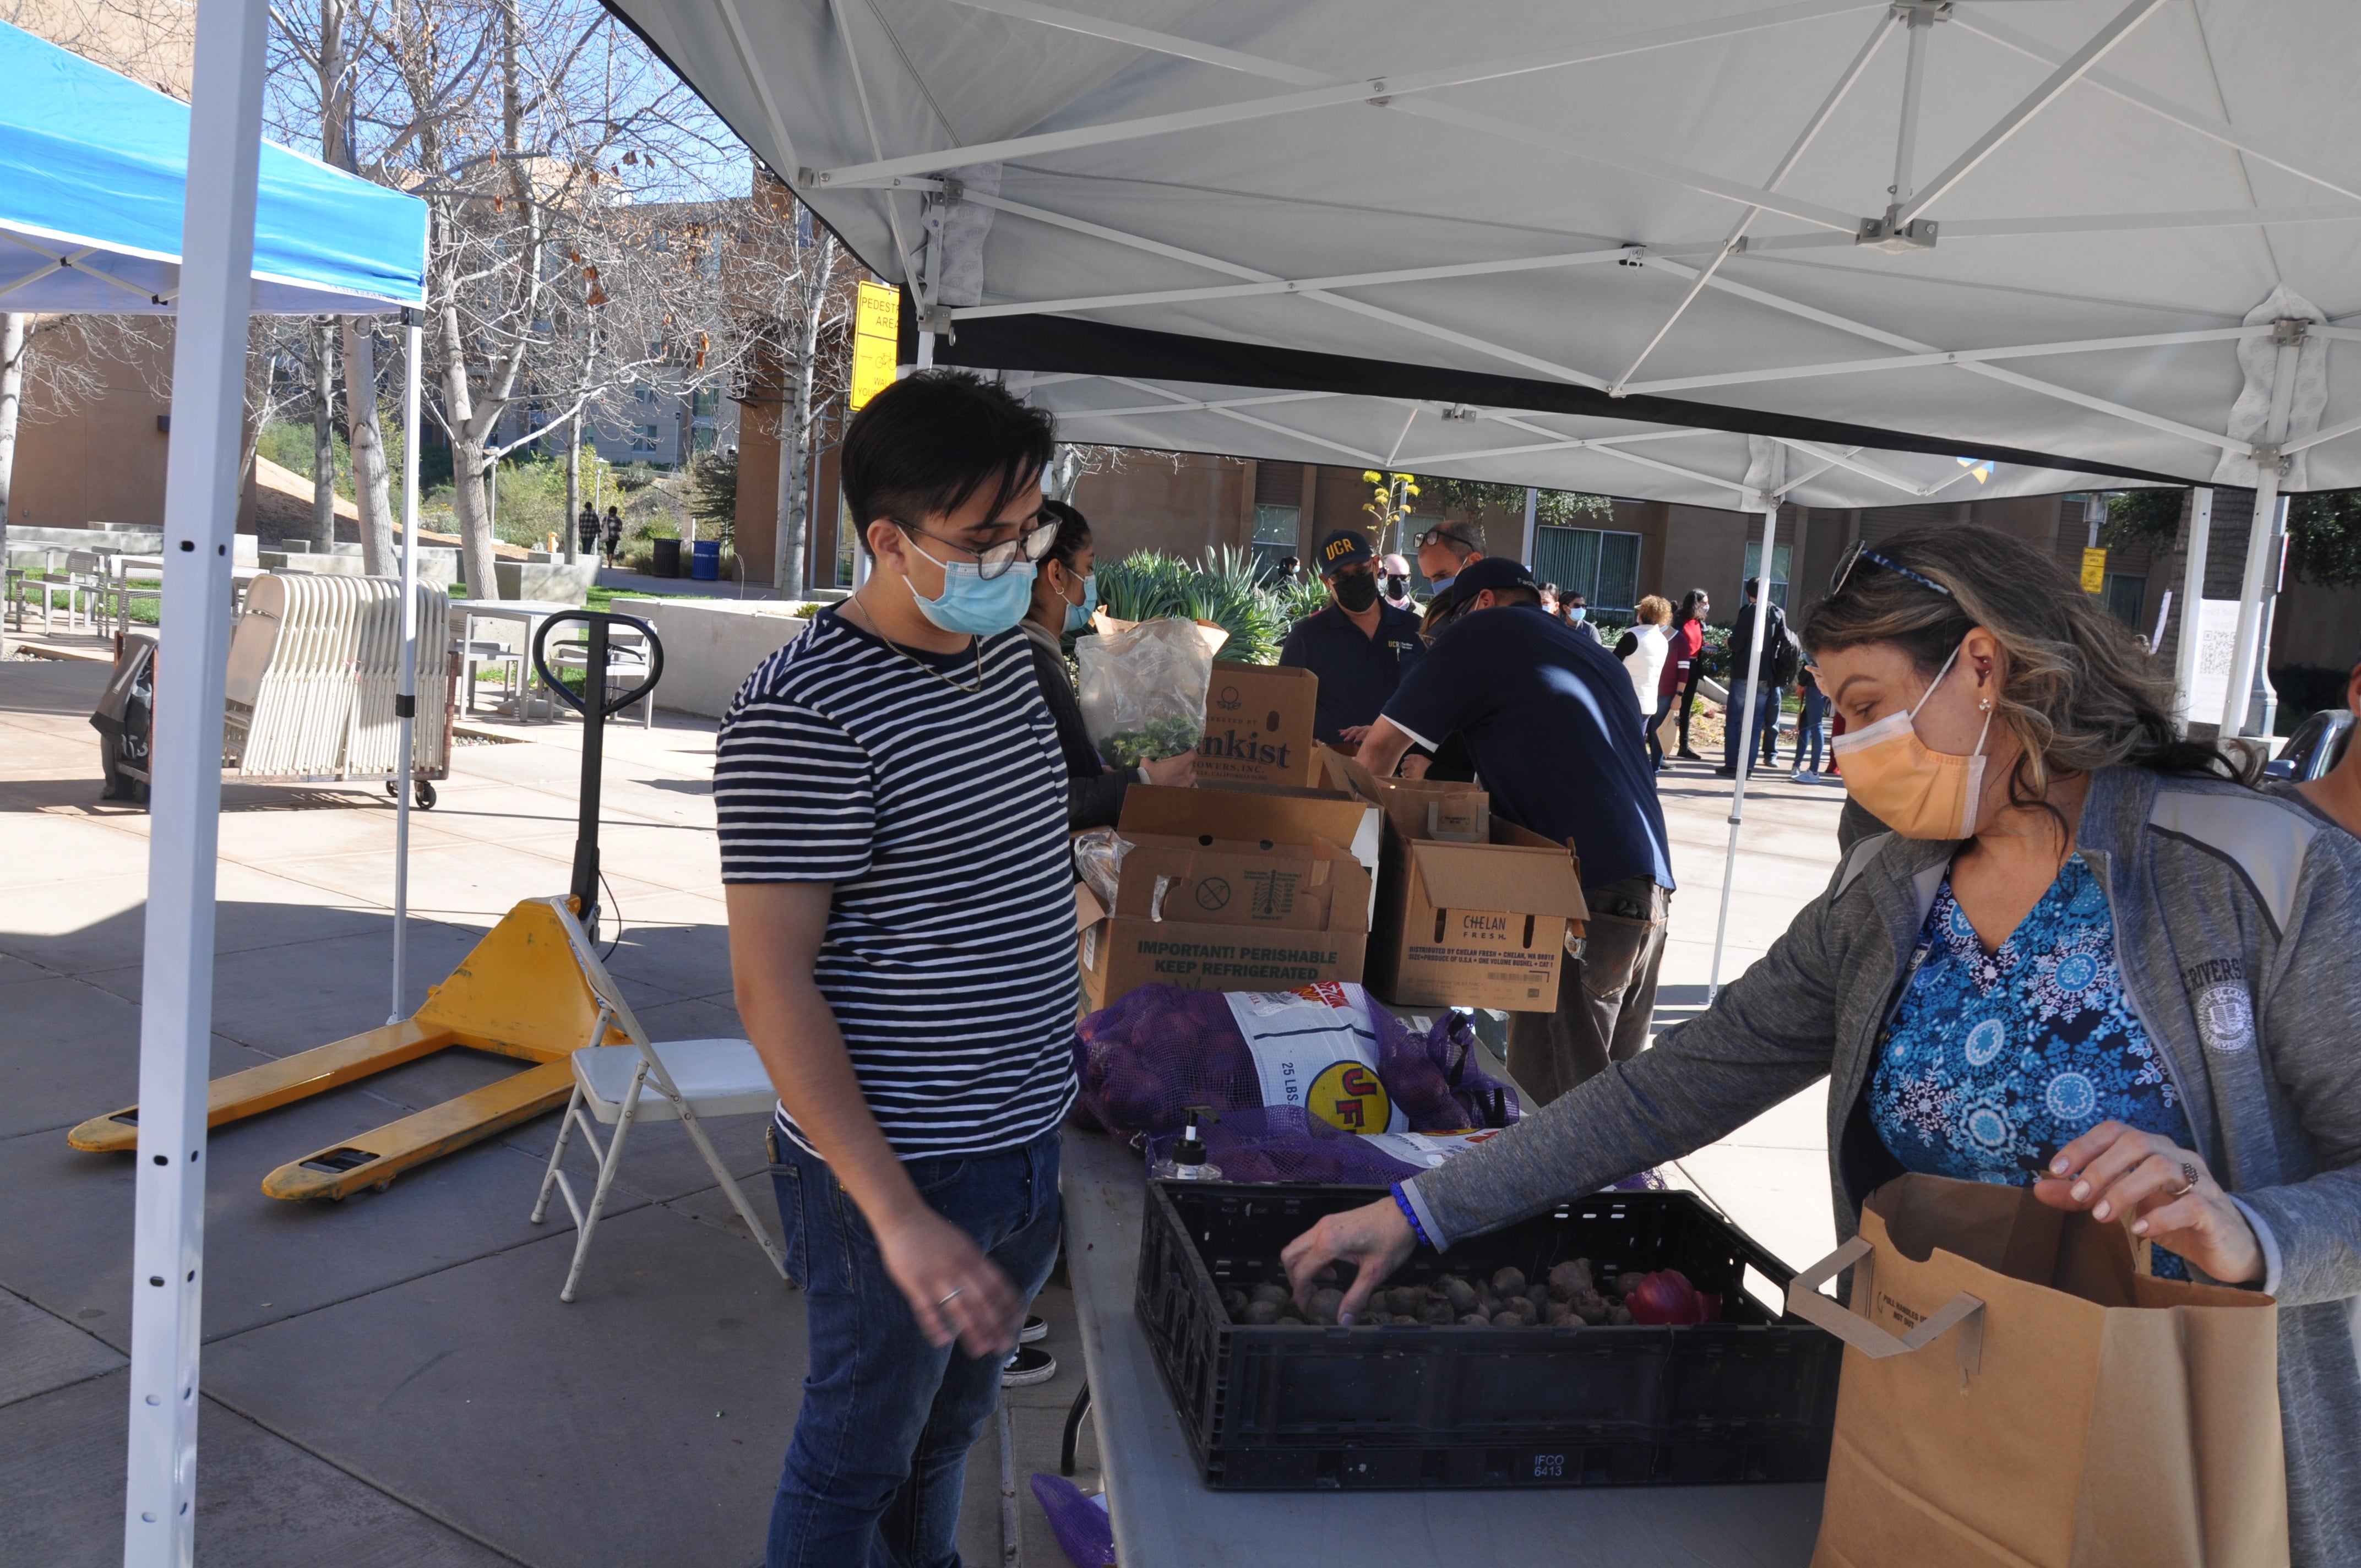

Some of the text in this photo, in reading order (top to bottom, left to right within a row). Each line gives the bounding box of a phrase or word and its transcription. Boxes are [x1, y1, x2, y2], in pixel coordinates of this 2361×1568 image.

[1326, 538, 1354, 560] UCR
[1464, 915, 1506, 930] CHELAN
[1137, 941, 1338, 964] IMPORTANT! PERISHABLE
[1410, 946, 1445, 954] DISTRIBUTED
[1155, 960, 1319, 980] KEEP REFRIGERATED
[1282, 1063, 1299, 1105] 25 LBS.
[1883, 1294, 1895, 1308] PULL
[1896, 1302, 1919, 1321] HANDLES
[1904, 1317, 1914, 1329] OUT
[1535, 1455, 1564, 1466] IFCO
[1535, 1466, 1562, 1477] 6413
